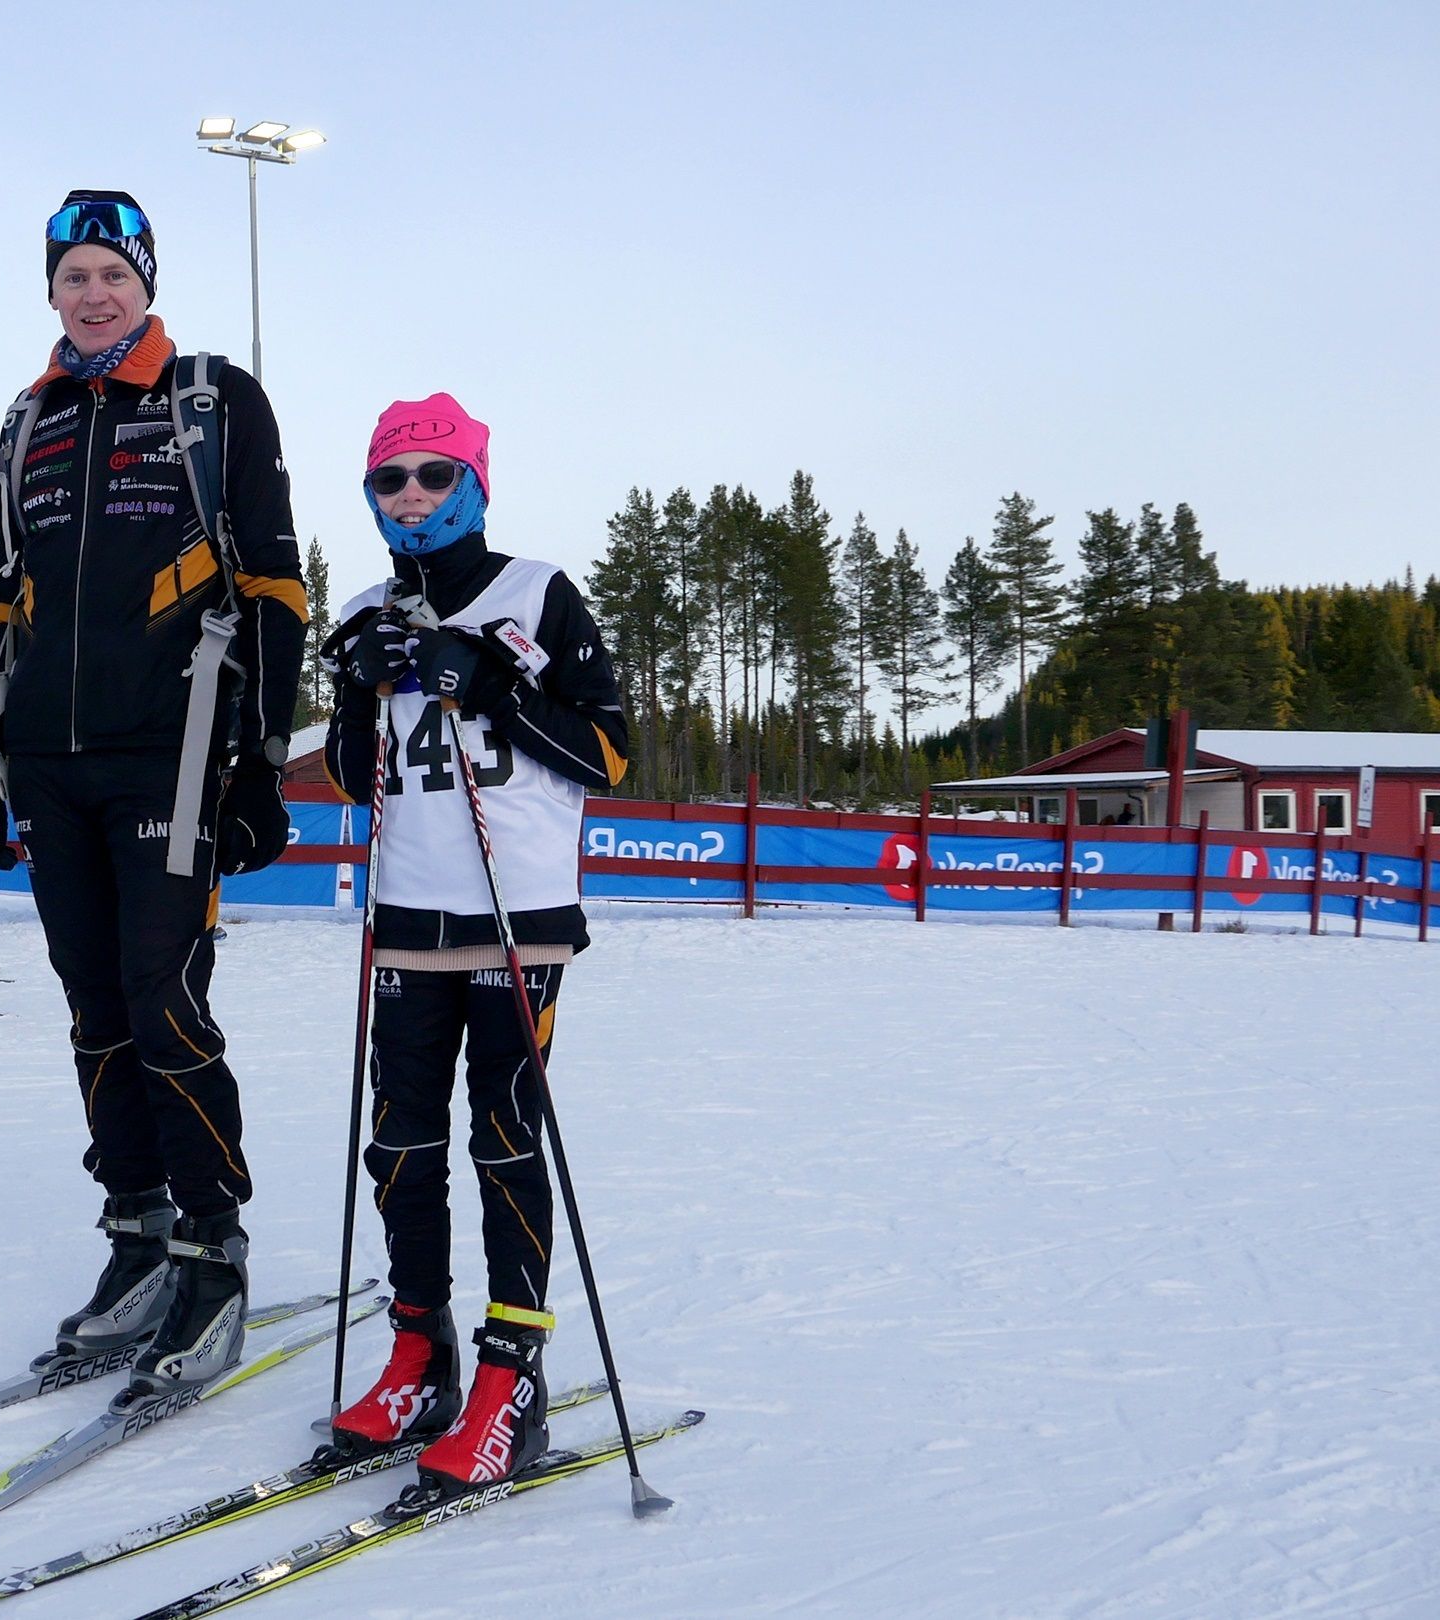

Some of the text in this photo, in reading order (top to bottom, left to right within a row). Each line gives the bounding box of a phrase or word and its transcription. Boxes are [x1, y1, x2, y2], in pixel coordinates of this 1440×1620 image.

[34, 404, 79, 430] TRIMTEX
[105, 501, 175, 515] REMA 1000
[137, 818, 172, 839] LÅN
[112, 1270, 164, 1325] FISCHER
[195, 1302, 237, 1364] FISCHER
[484, 1334, 518, 1351] alpina
[38, 1347, 139, 1395] FISCHER
[122, 1384, 205, 1440] FISCHER
[469, 1376, 535, 1483] alpina
[333, 1442, 427, 1486] FISCHER
[423, 1480, 516, 1530] FISCHER
